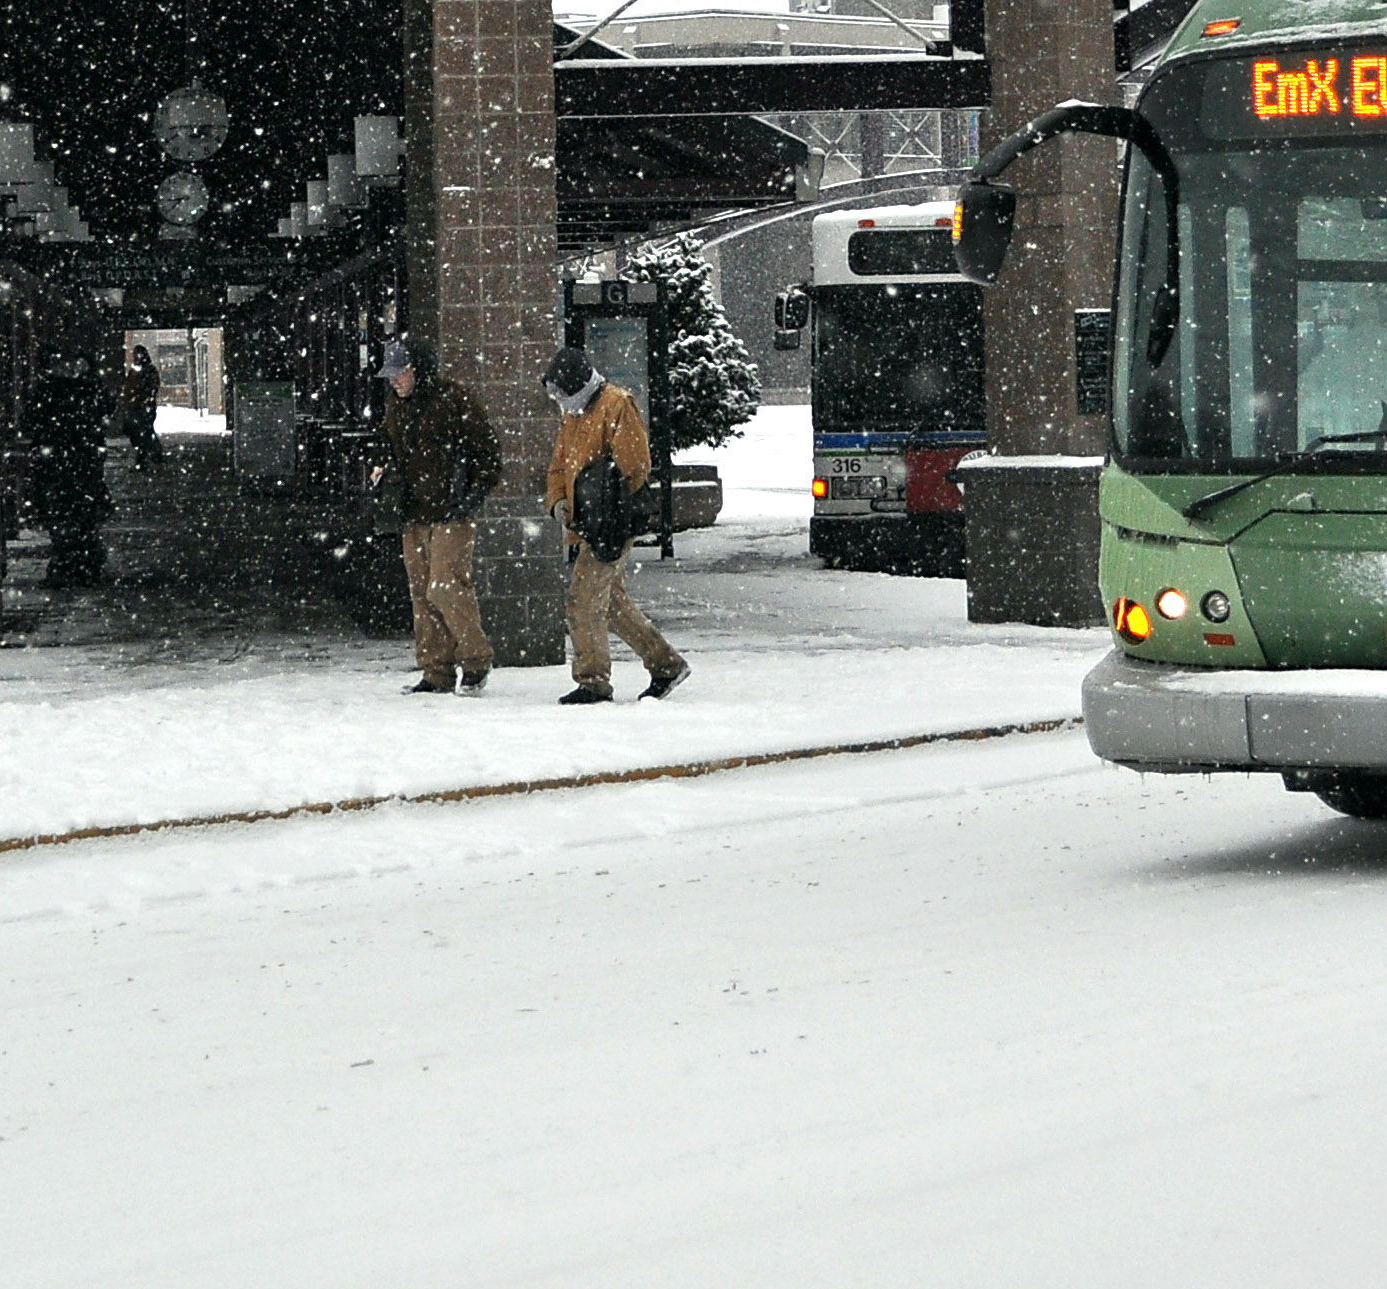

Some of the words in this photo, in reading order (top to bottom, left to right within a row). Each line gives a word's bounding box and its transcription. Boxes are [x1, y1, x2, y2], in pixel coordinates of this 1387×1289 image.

[1253, 59, 1339, 116] EmX
[607, 283, 624, 304] G
[832, 458, 862, 474] 316
